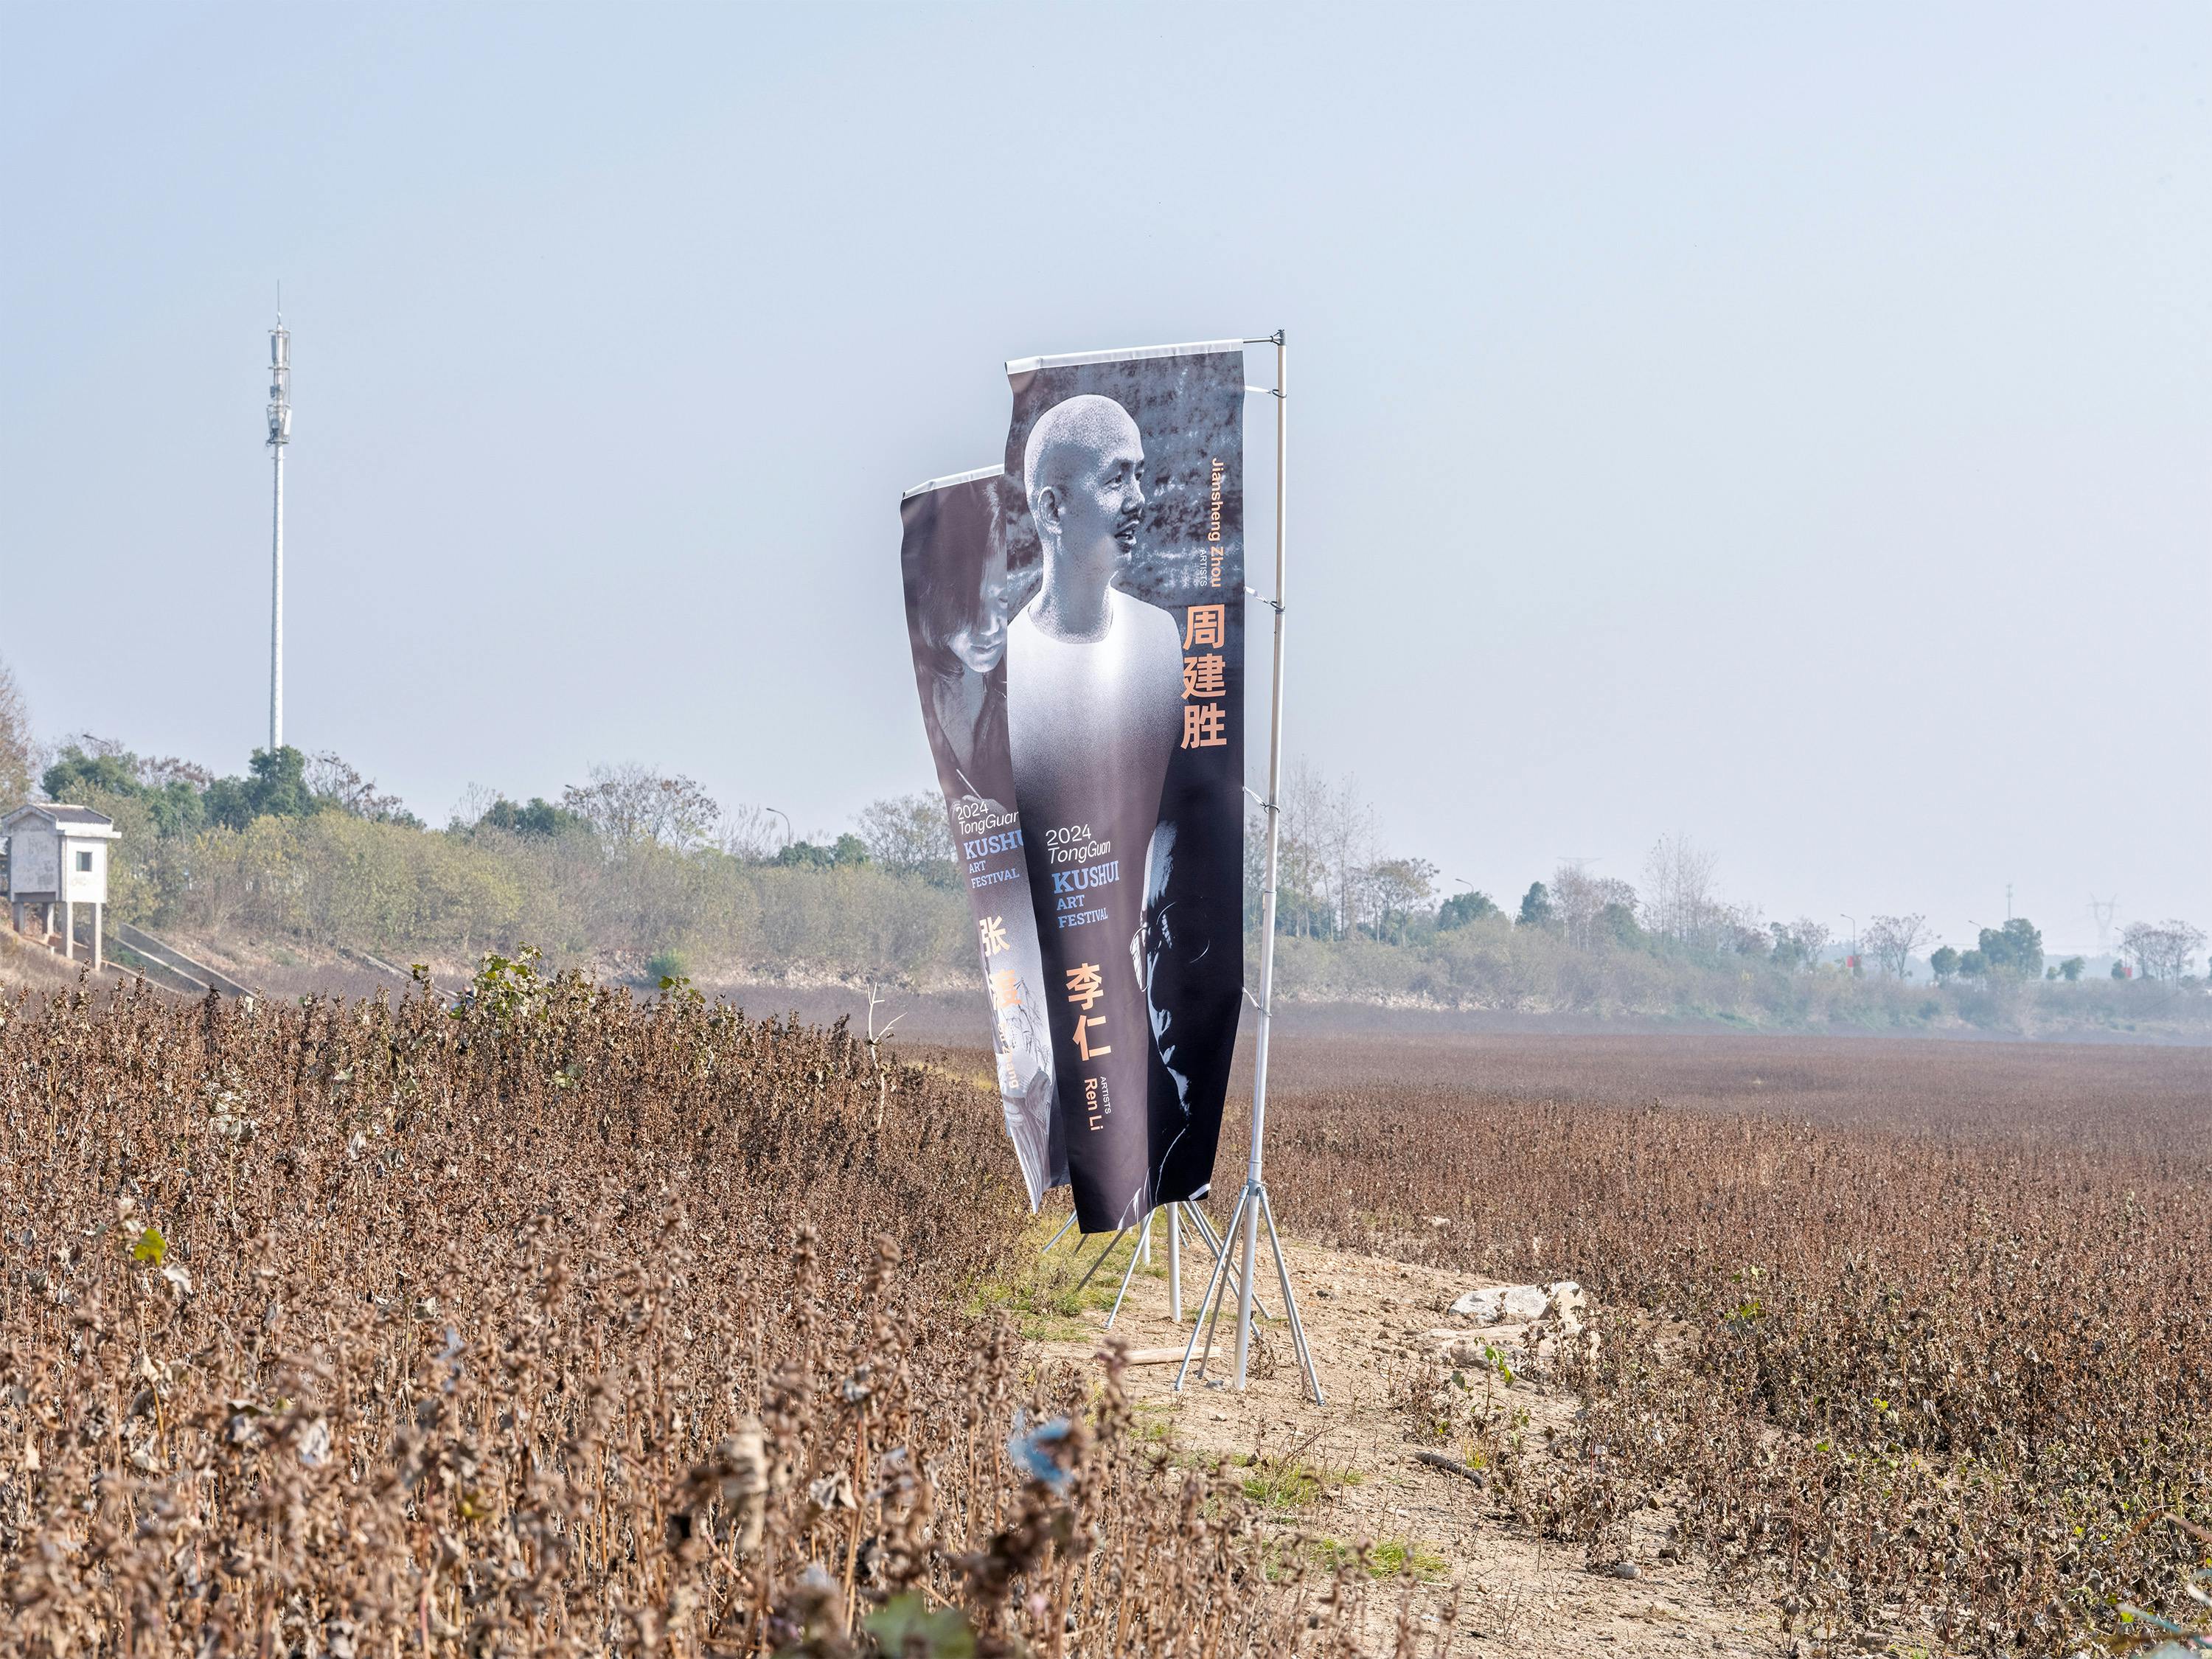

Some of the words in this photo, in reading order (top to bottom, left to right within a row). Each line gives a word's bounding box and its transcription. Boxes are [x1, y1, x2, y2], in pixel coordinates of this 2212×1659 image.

[1207, 457, 1224, 542] Jiansheng
[1211, 546, 1224, 588] Zhou
[1180, 604, 1227, 750] 周建胜
[956, 801, 989, 820] 2024
[1046, 824, 1091, 846] 2024
[1048, 840, 1110, 864] TongGuan
[969, 860, 987, 874] ART
[971, 868, 1020, 888] FESTIVAL
[1051, 860, 1120, 894] KUSHUI
[1056, 894, 1085, 911] ART
[1058, 907, 1108, 928] FESTIVAL
[1065, 962, 1112, 1062] 李仁
[1084, 1077, 1099, 1111] Ren
[1100, 1076, 1111, 1115] ARTISTS
[1089, 1114, 1104, 1132] Li
